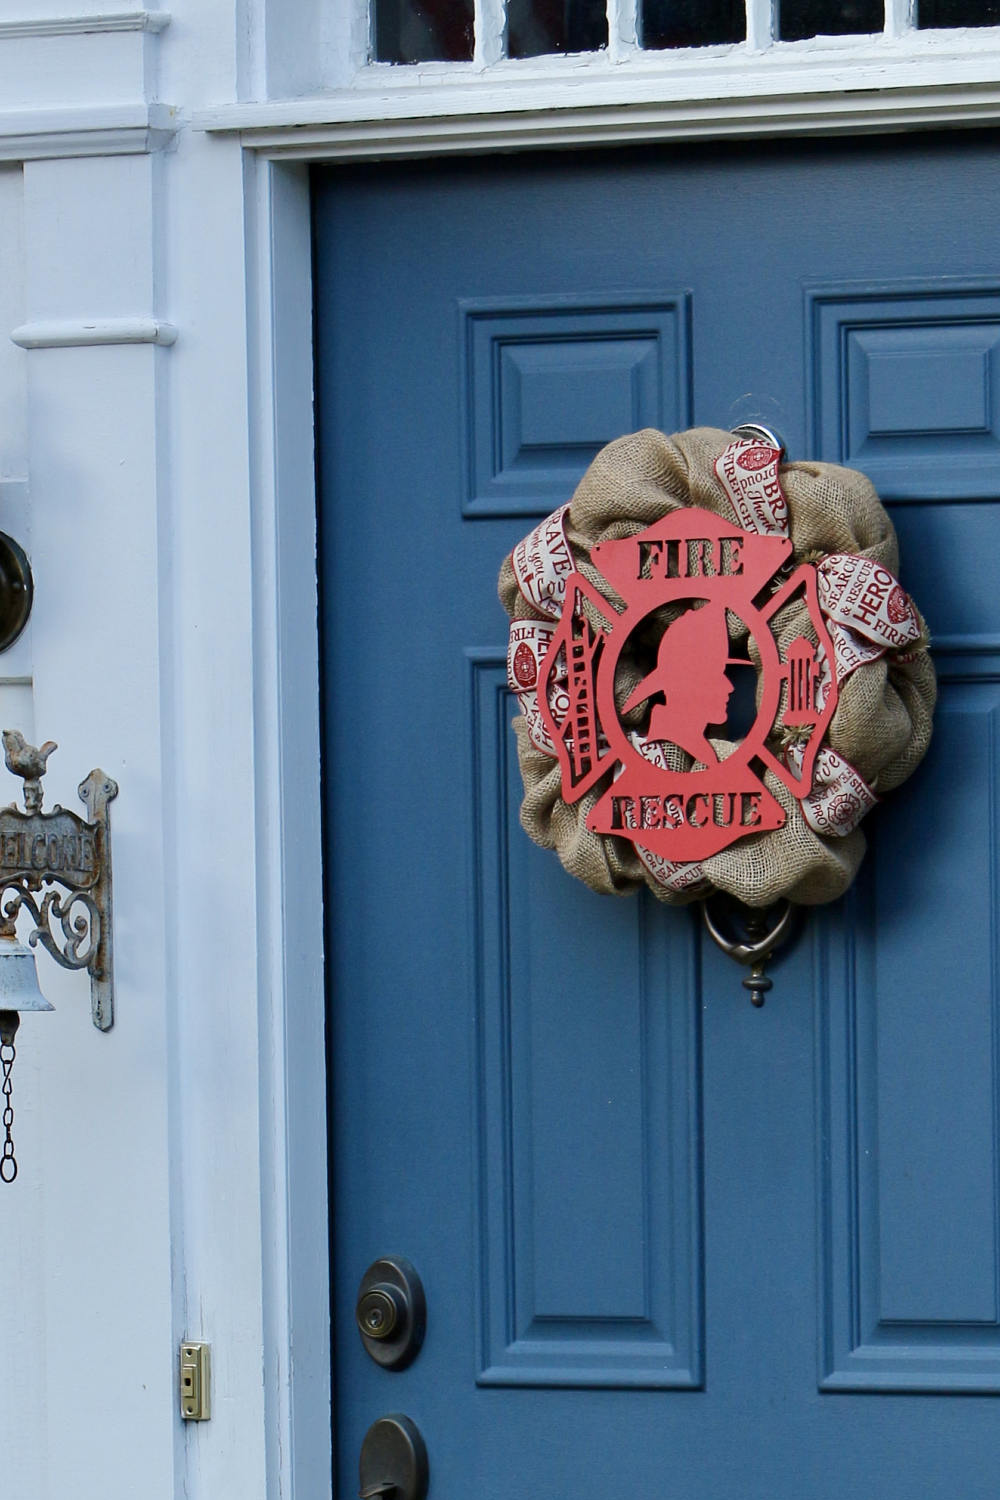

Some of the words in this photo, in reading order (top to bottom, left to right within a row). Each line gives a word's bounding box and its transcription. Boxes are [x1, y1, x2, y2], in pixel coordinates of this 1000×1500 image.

[740, 463, 776, 494] proud
[637, 537, 744, 580] FIRE
[828, 557, 859, 610] SEARCH
[841, 607, 852, 616] &
[849, 562, 874, 605] RESCUE
[853, 570, 892, 625] HERO
[610, 792, 762, 829] RESCUE
